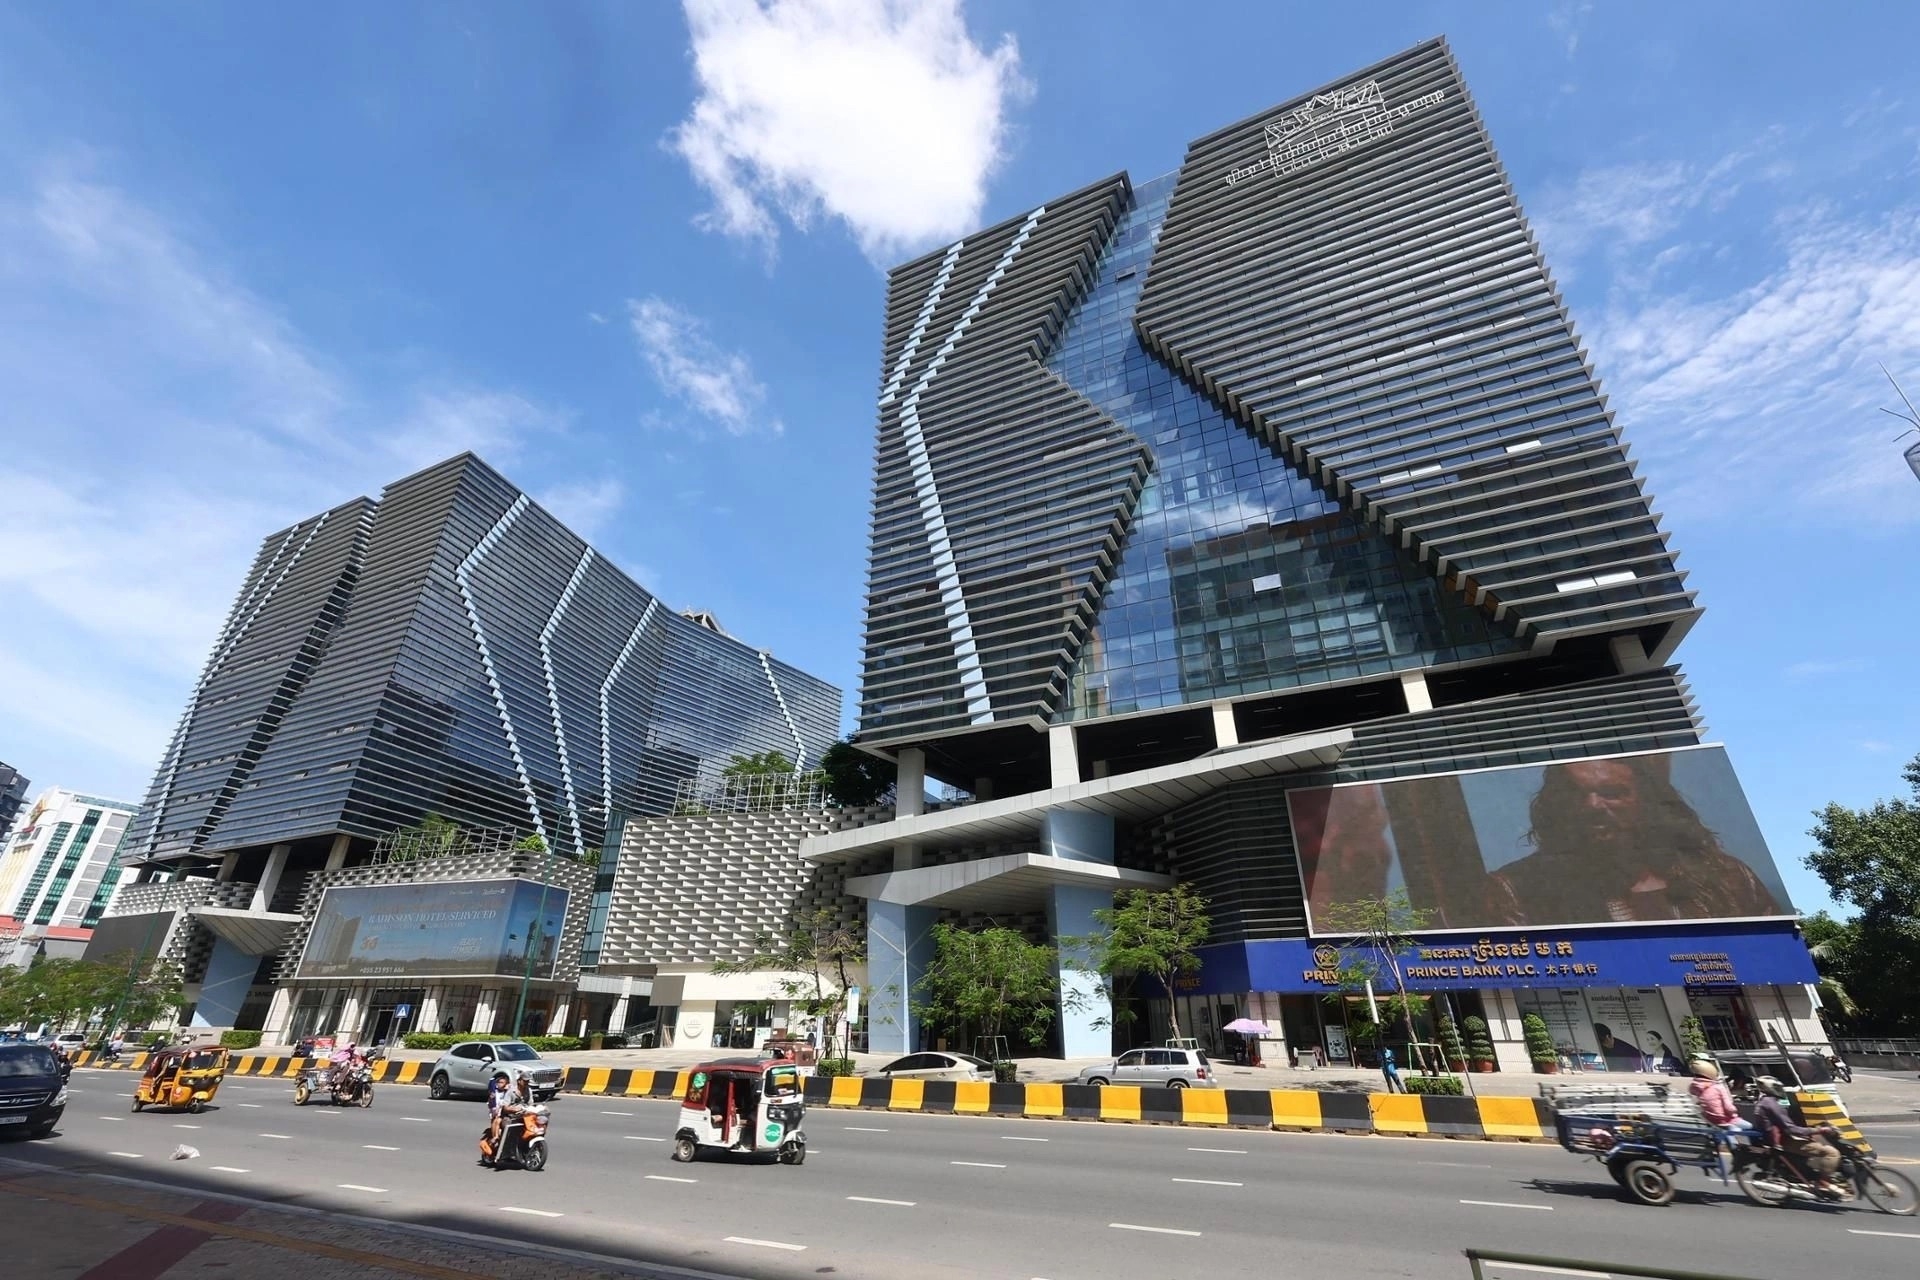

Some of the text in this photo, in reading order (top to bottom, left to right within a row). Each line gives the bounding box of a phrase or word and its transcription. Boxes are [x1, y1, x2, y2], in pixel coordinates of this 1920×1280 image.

[448, 910, 497, 921] SERVICED
[1407, 964, 1540, 977] PRINCE BANK PLC.
[1546, 963, 1598, 975] 太子银行
